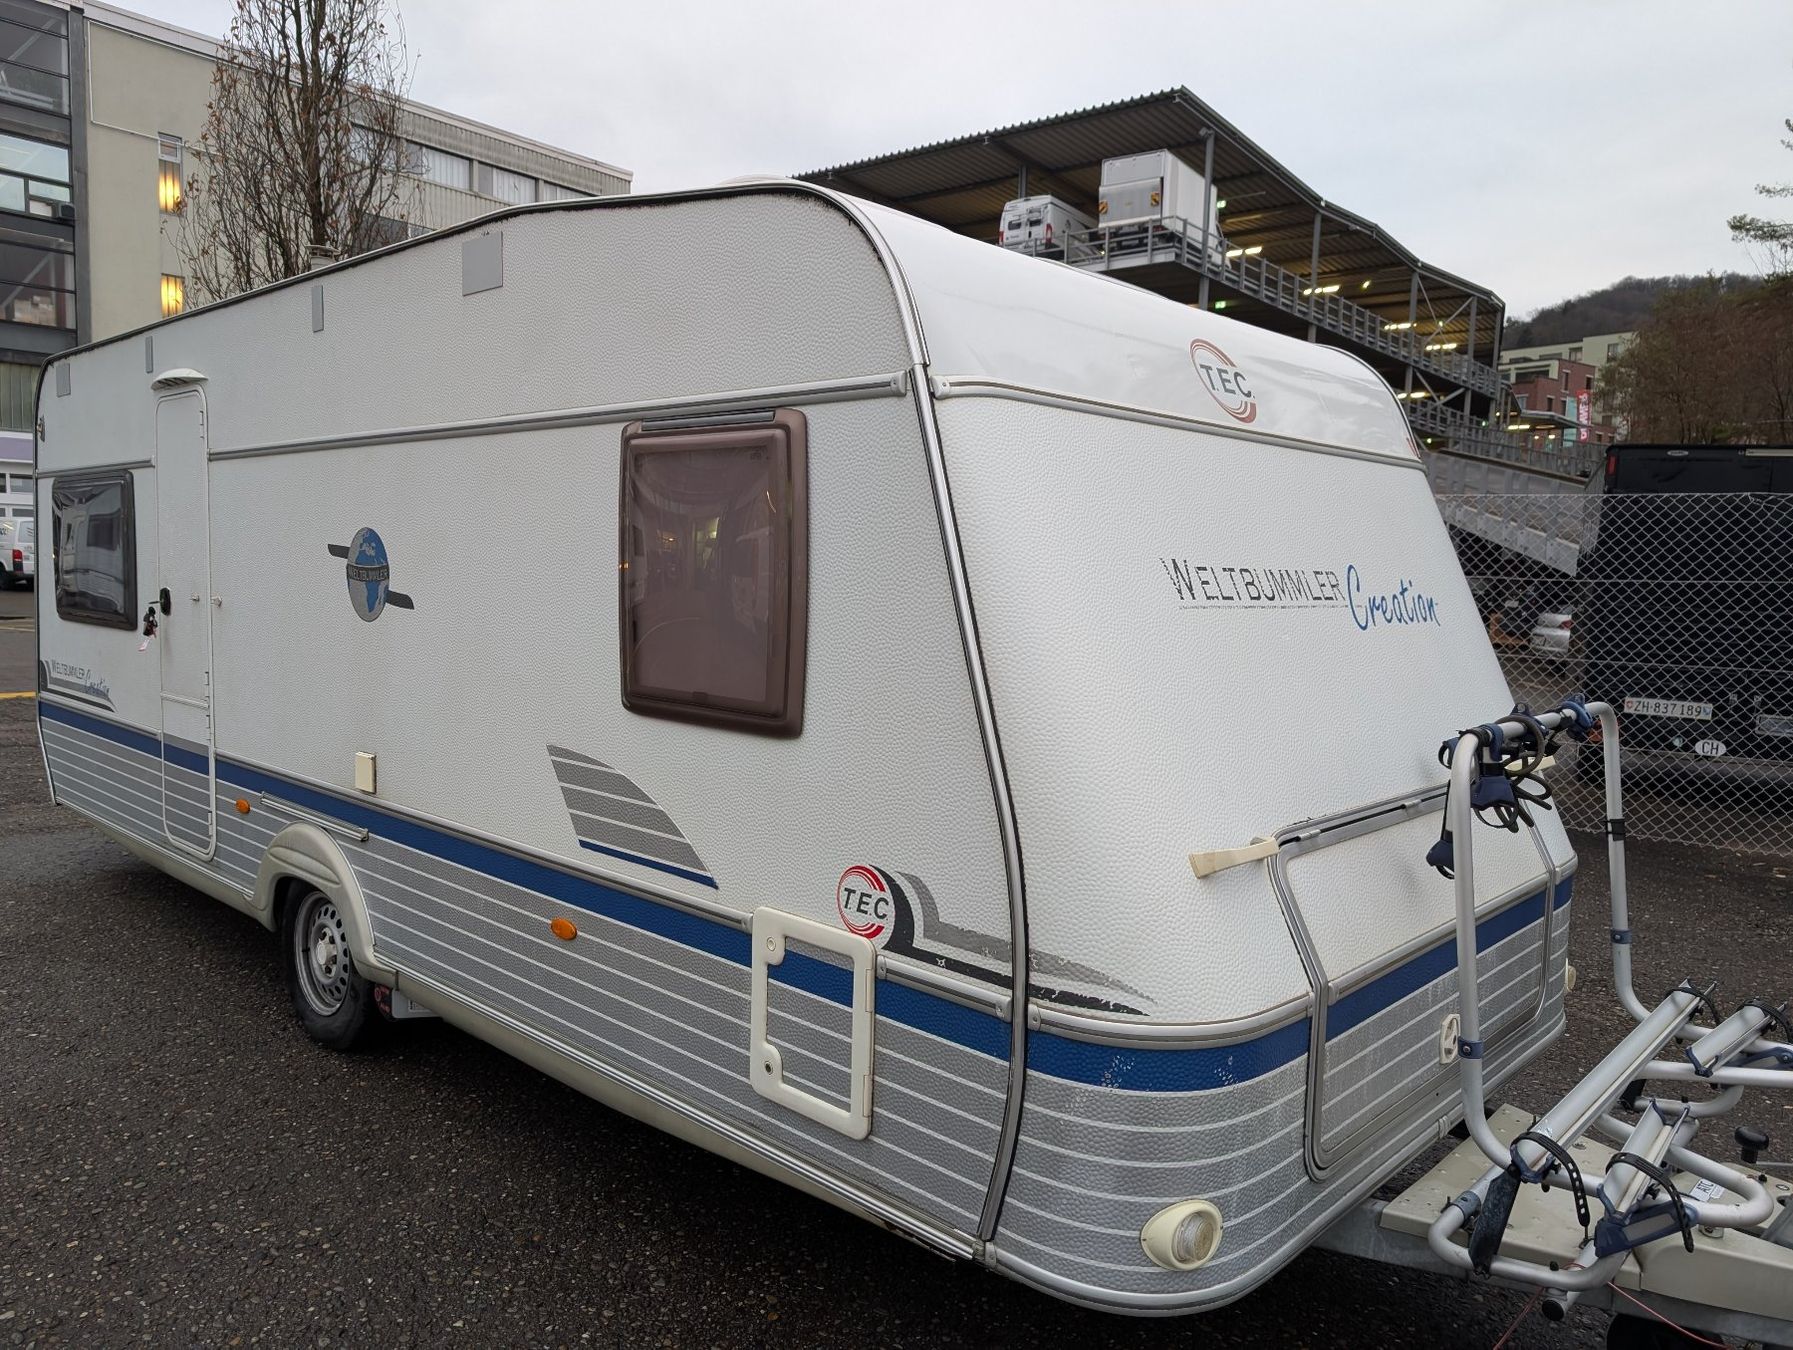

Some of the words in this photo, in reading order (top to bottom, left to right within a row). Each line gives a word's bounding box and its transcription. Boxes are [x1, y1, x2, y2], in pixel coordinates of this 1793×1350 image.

[1160, 558, 1346, 601] WELTBUMMLER
[1347, 564, 1440, 630] Creation
[1701, 741, 1720, 756] CH
